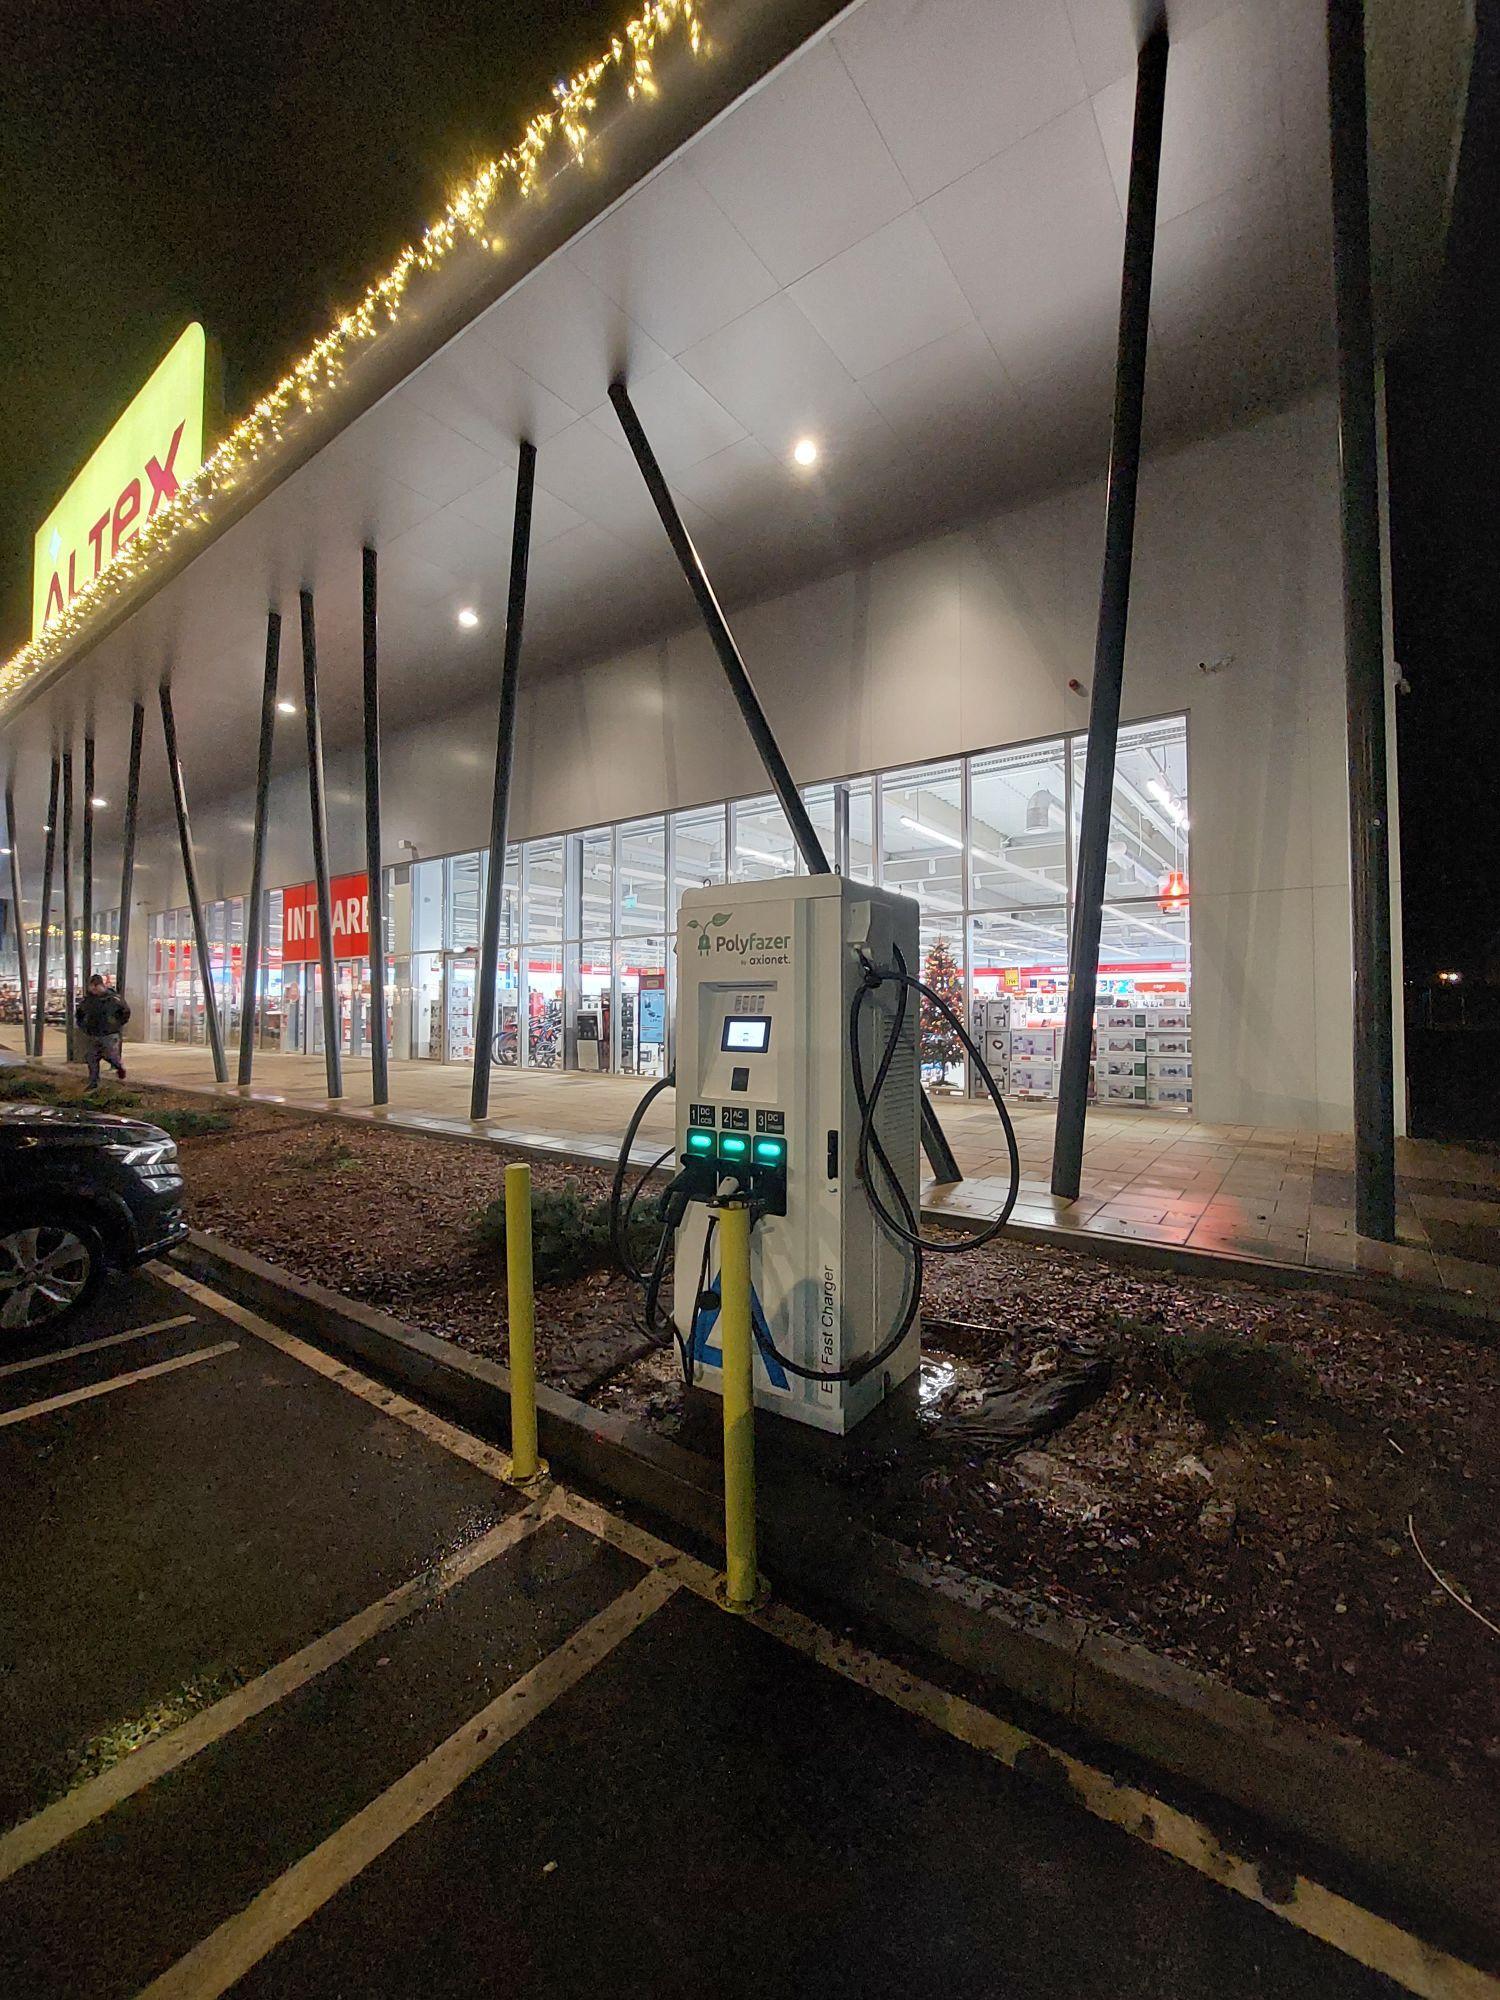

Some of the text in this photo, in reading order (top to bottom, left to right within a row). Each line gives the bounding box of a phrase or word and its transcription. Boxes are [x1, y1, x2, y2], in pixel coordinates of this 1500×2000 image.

[287, 895, 369, 942] INTARE
[716, 933, 791, 955] Polyfazer
[691, 1109, 696, 1120] 1
[700, 1107, 710, 1115] DC
[723, 1112, 729, 1122] 2
[758, 1115, 764, 1126] 3
[767, 1114, 779, 1122] DC
[821, 1264, 837, 1328] Charger
[821, 1332, 834, 1365] Fast
